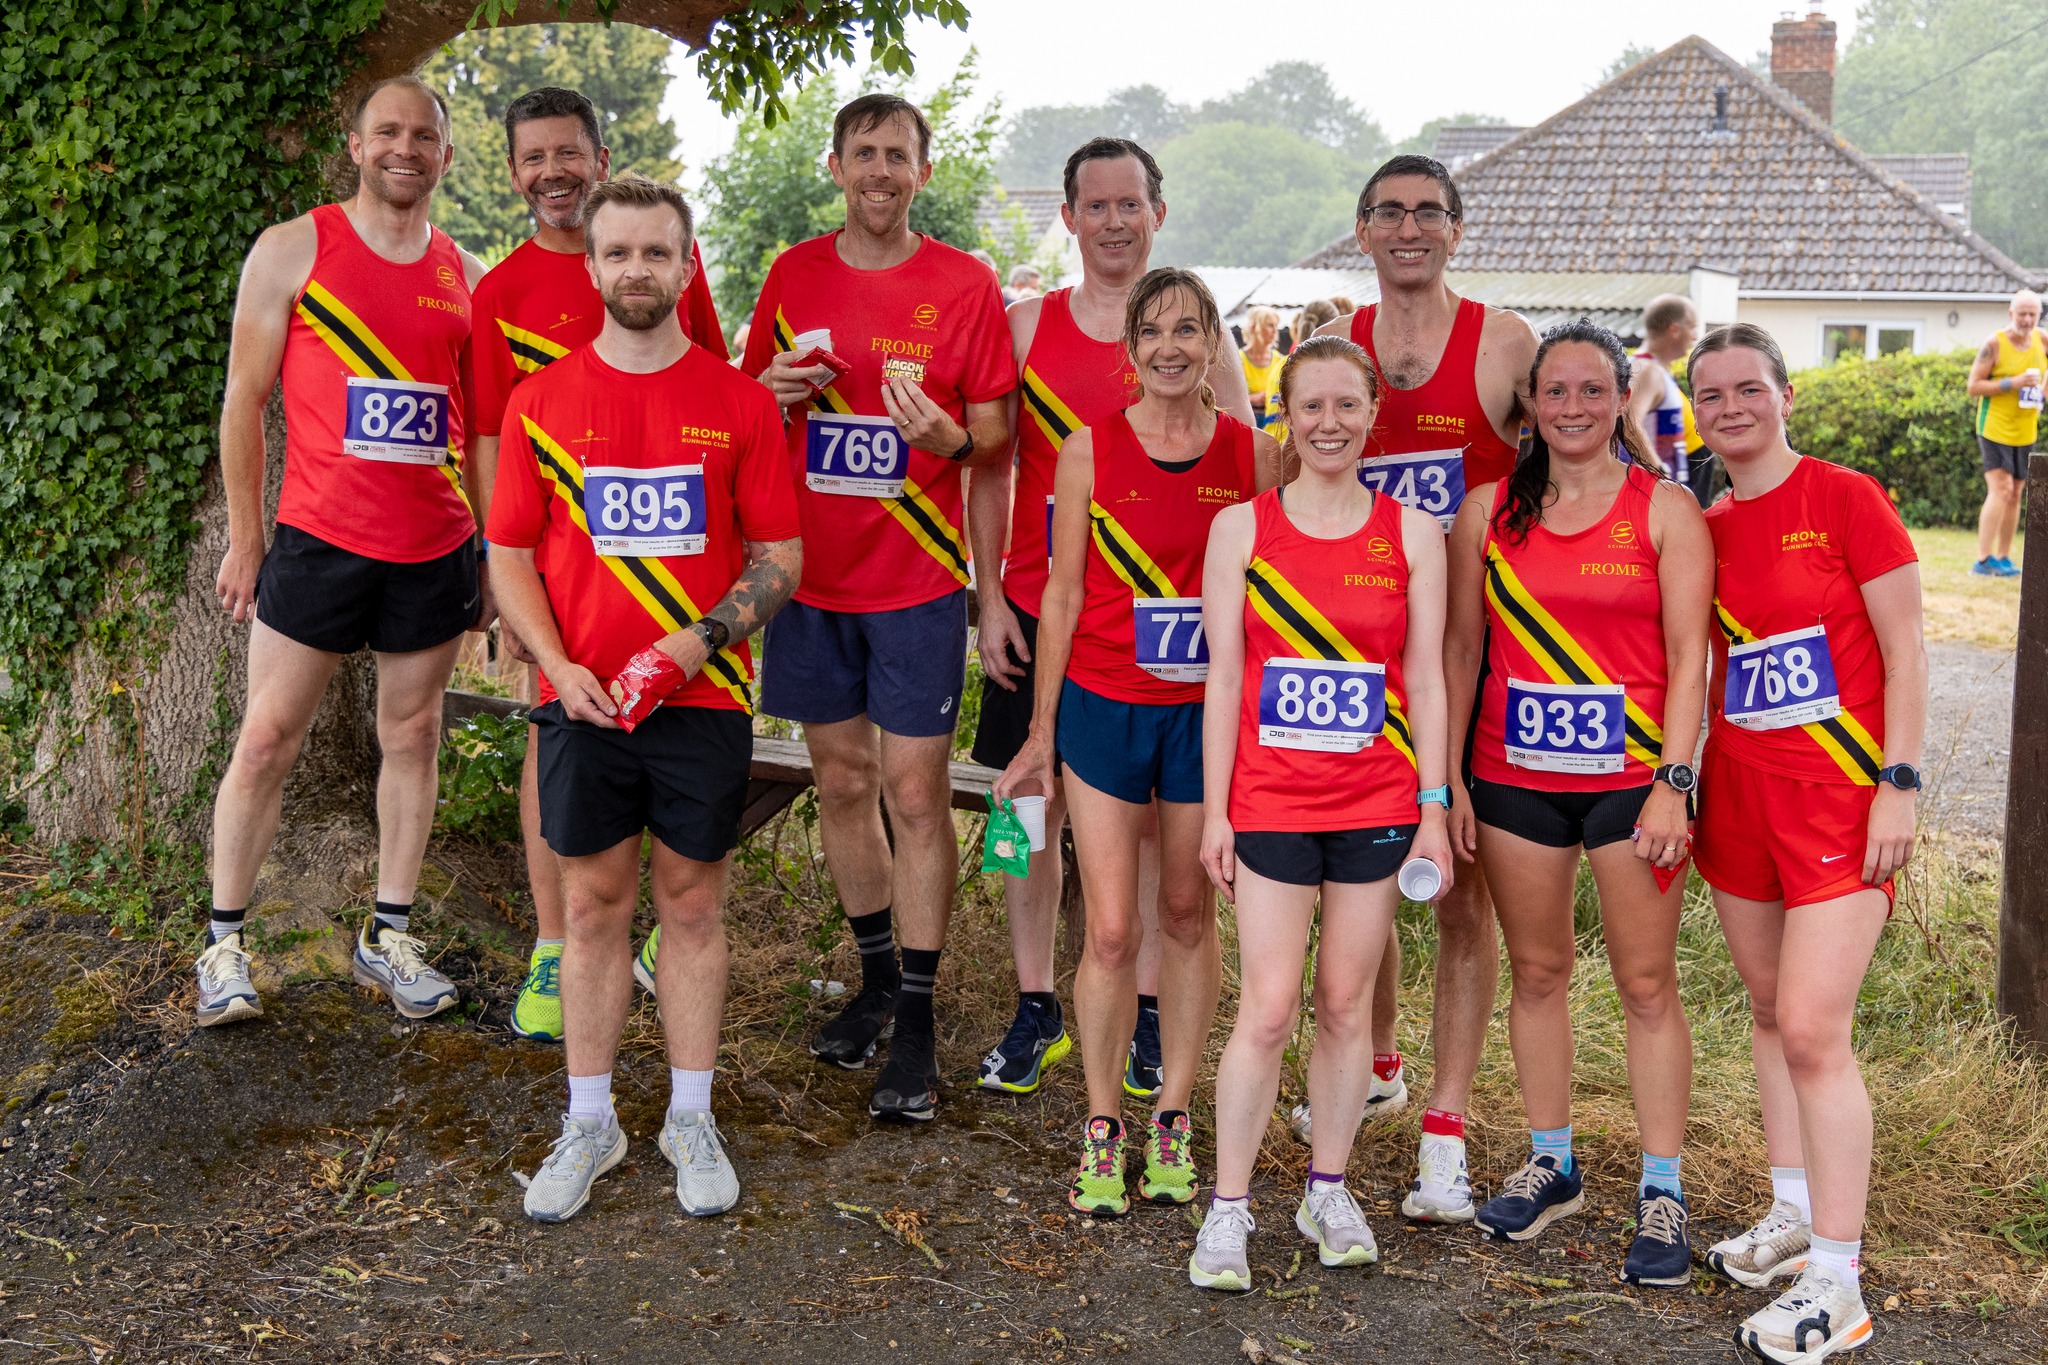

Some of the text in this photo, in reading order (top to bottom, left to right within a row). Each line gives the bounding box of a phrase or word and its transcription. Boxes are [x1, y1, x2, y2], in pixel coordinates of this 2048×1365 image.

[417, 296, 465, 317] FROME
[870, 337, 934, 358] FROME
[361, 392, 438, 442] 823
[1417, 414, 1466, 428] FROME
[682, 426, 731, 442] FROME
[682, 438, 712, 446] RUNNING
[820, 426, 898, 474] 769
[1198, 486, 1240, 499] FROME
[1365, 465, 1450, 512] 743
[602, 481, 691, 532] 895
[1782, 530, 1828, 544] FROME
[1782, 542, 1813, 552] RUNNING
[1580, 563, 1640, 576] FROME
[1344, 574, 1397, 591] FROME
[1152, 613, 1204, 658] 77
[1742, 646, 1819, 707] 768
[1276, 673, 1369, 727] 883
[1518, 696, 1608, 750] 933
